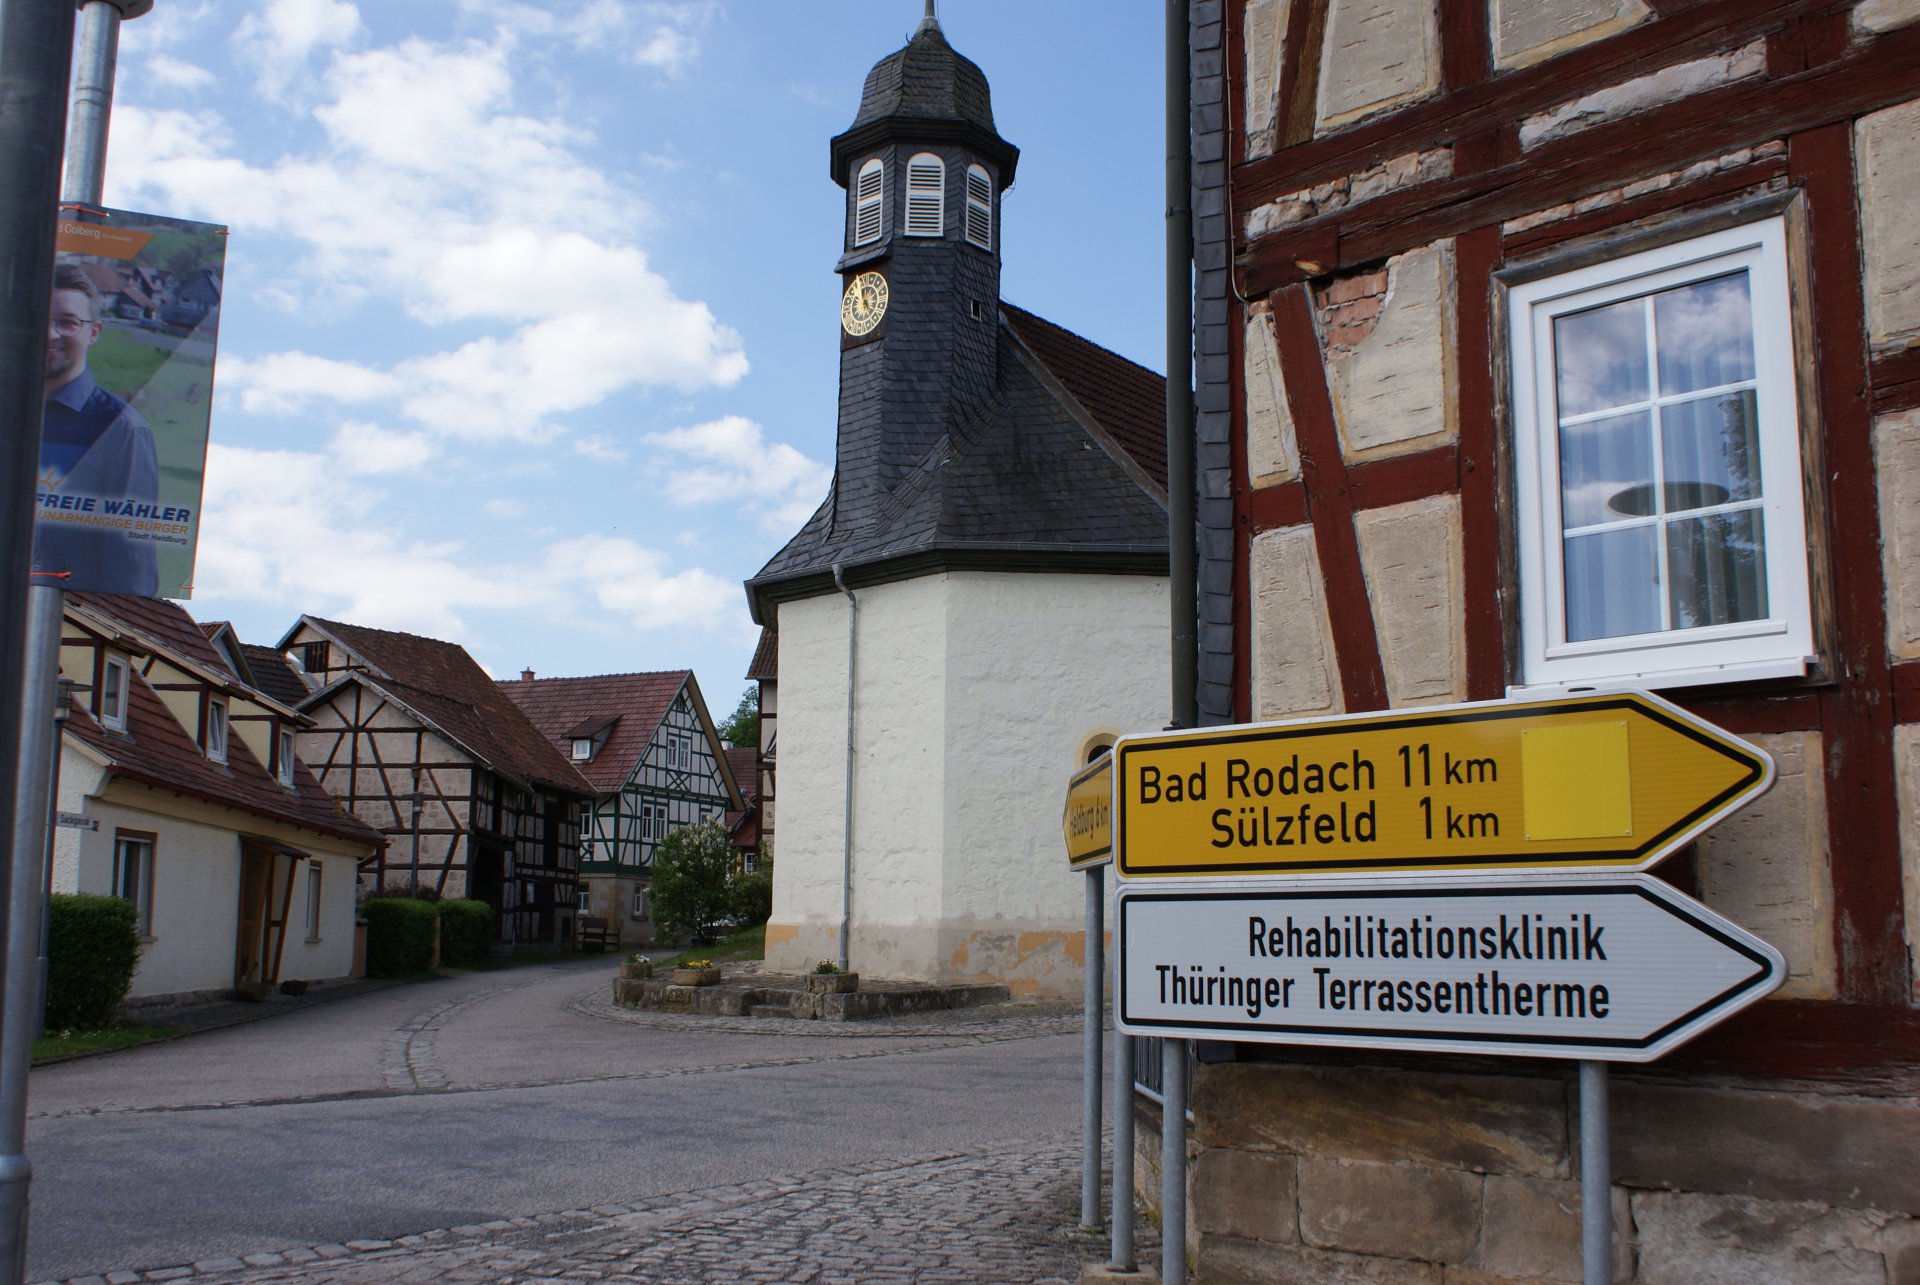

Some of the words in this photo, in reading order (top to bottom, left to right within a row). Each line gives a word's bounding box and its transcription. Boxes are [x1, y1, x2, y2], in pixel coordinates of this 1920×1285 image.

[64, 223, 100, 239] Colberg
[36, 493, 96, 511] FREIE
[104, 499, 191, 522] WÄHLER
[128, 531, 150, 541] Stadt
[151, 534, 188, 546] Heldburg
[1139, 761, 1207, 805] Bad
[1226, 749, 1376, 799] Rodach
[1398, 743, 1431, 788] 11
[1444, 751, 1498, 785] km
[1070, 803, 1094, 840] Heldburg
[1210, 800, 1377, 849] Sülzfeld
[1419, 796, 1432, 840] 1
[1446, 805, 1500, 839] km
[1248, 913, 1608, 962] Rehabilitationsklinik
[1155, 964, 1296, 1019] Thüringer
[1312, 967, 1610, 1020] Terrassentherme
